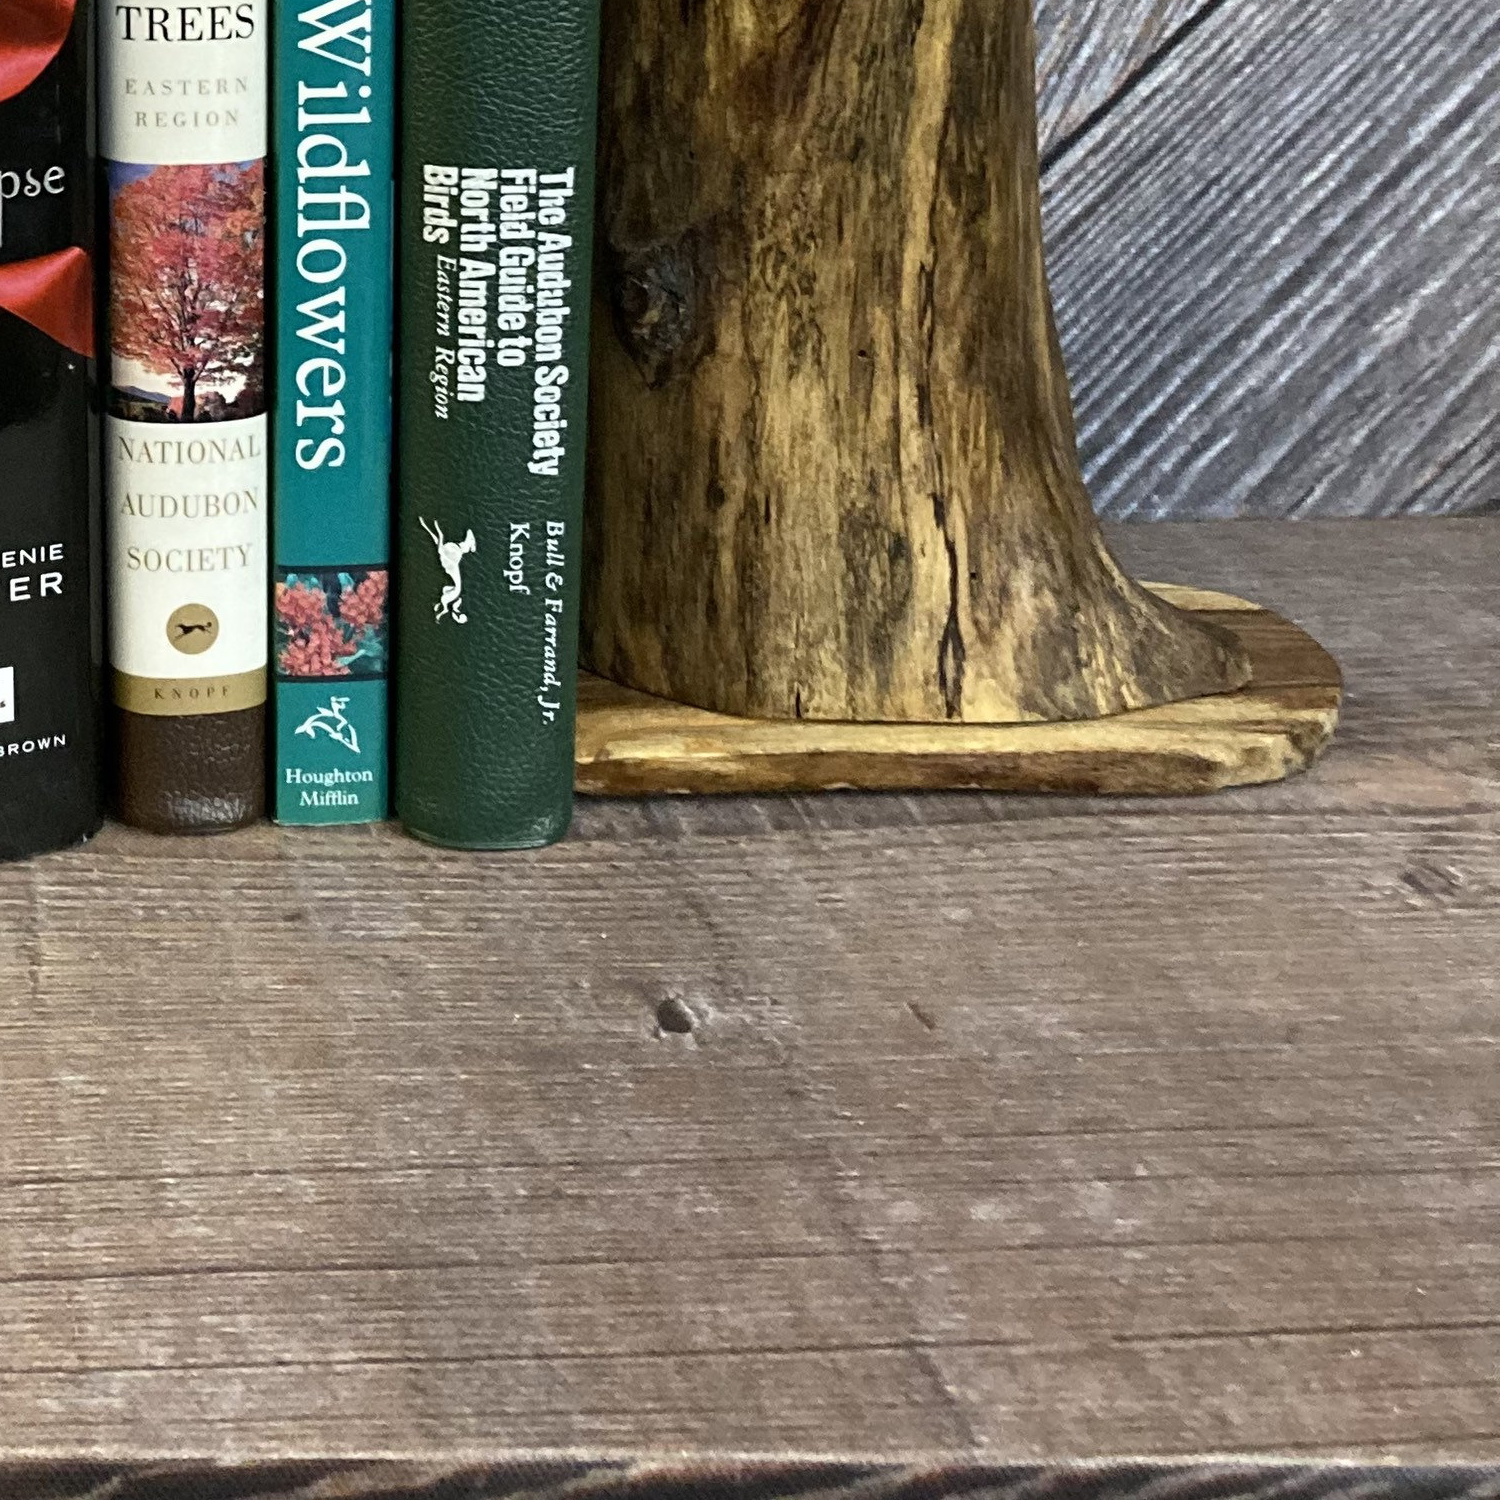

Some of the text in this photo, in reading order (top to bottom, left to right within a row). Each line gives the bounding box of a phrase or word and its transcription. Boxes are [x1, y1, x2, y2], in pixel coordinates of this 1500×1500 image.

[115, 3, 255, 42] TREES
[125, 76, 249, 96] EASTERN
[135, 110, 239, 128] REGION
[496, 168, 538, 367] Field Guide to
[423, 164, 459, 420] Birds Eastern Region
[457, 168, 499, 402] North American
[527, 166, 575, 476] The Audubon Society
[119, 434, 261, 465] NATIONAL
[120, 487, 258, 519] AUDUBON
[127, 543, 253, 572] SOCIETY
[503, 522, 531, 595] Knopf
[537, 521, 565, 725] Bull & Farrand, Jr.
[154, 686, 229, 700] KNOPF
[285, 768, 374, 787] Houghton
[299, 790, 360, 806] Mifflin
